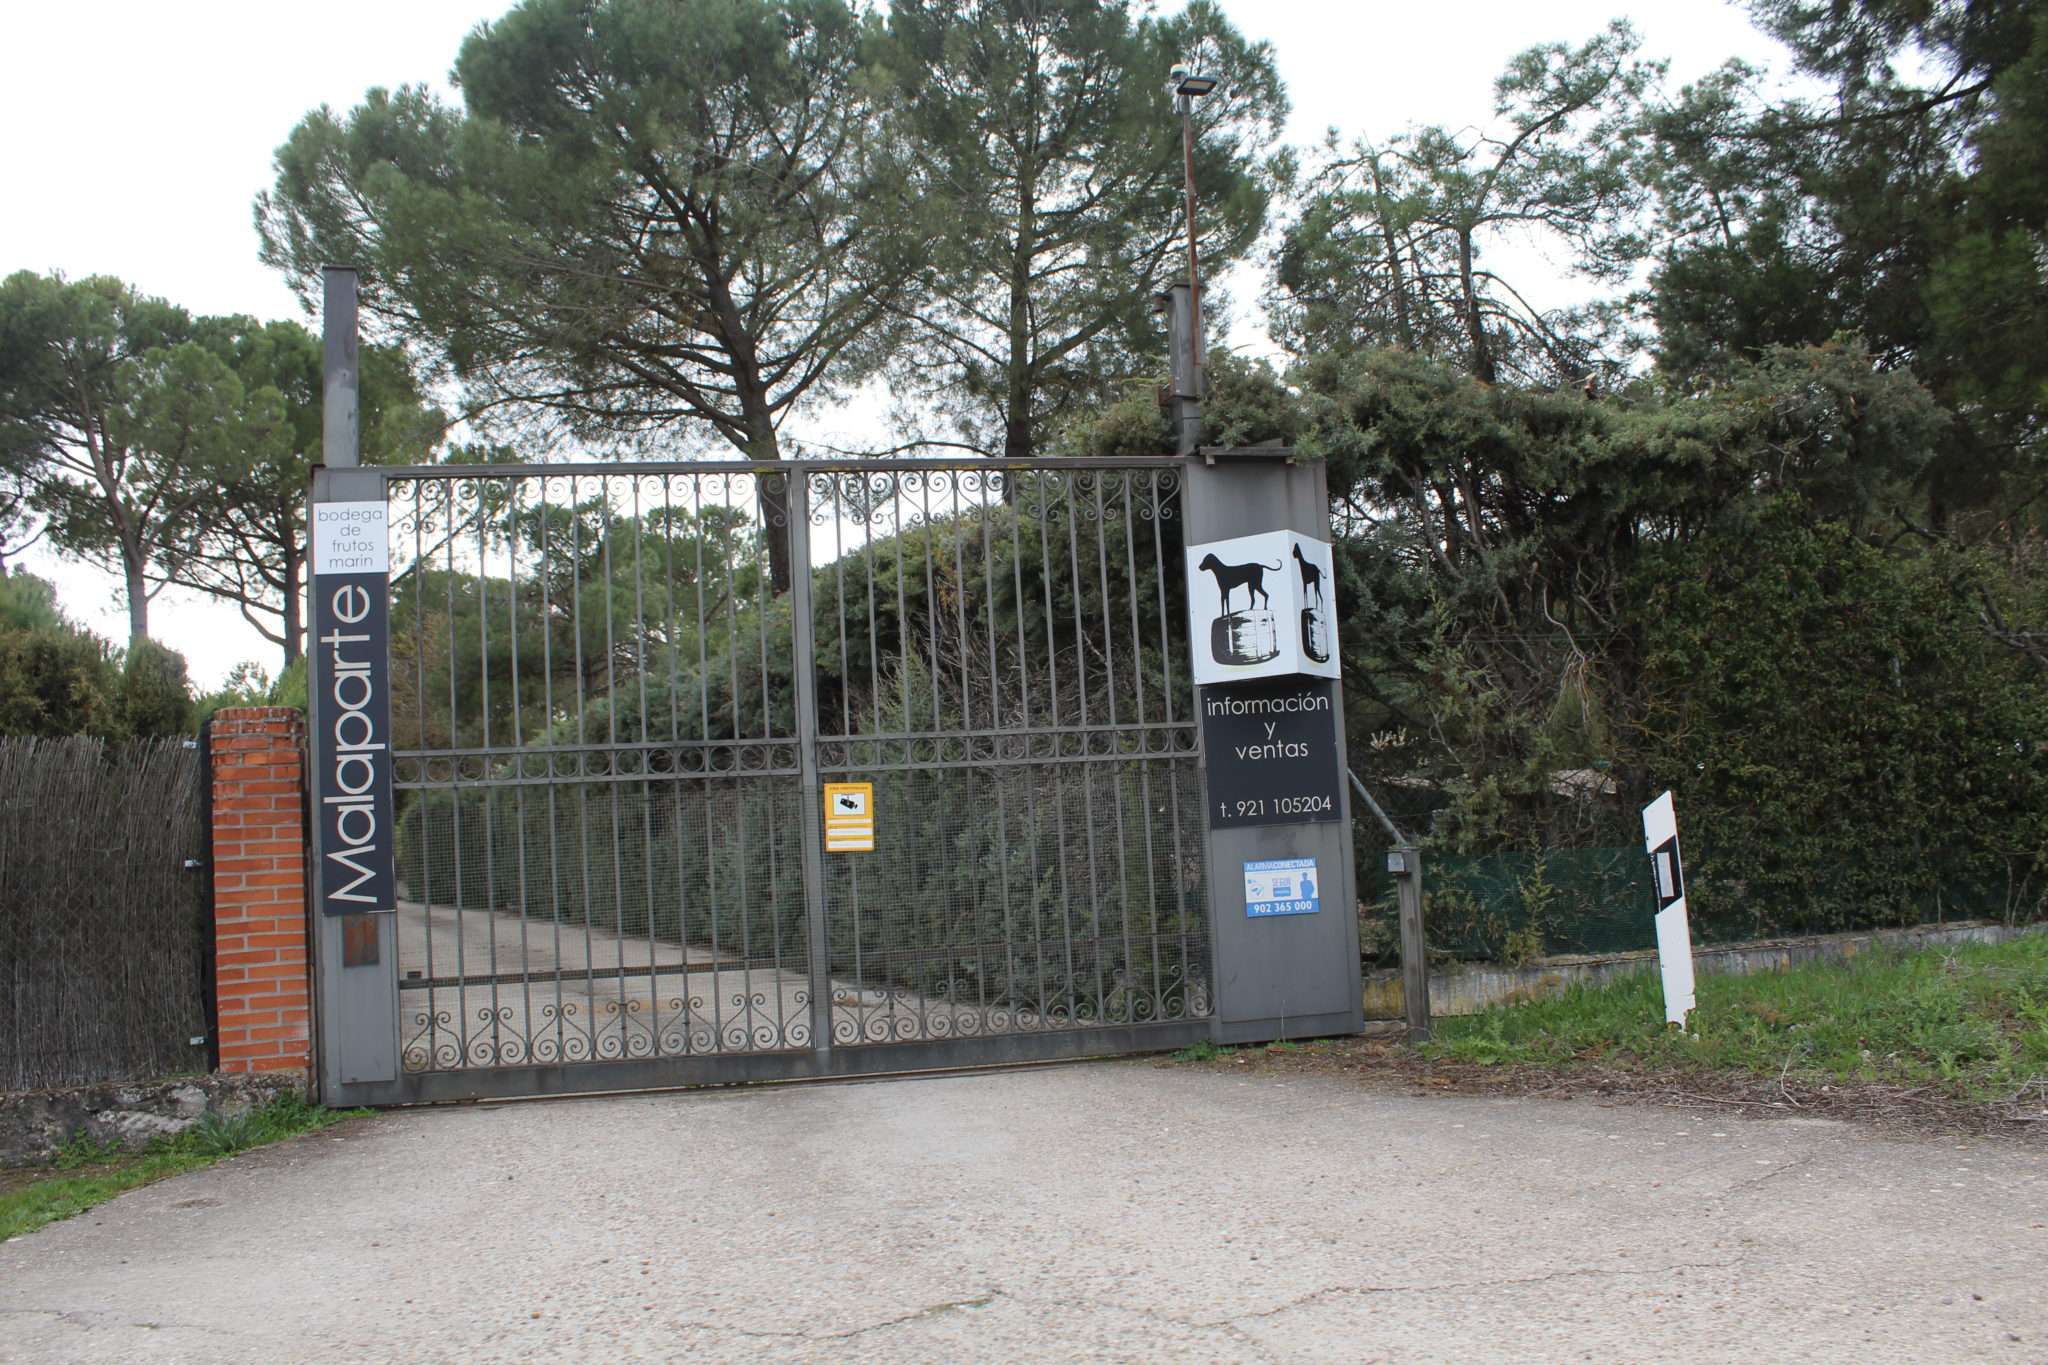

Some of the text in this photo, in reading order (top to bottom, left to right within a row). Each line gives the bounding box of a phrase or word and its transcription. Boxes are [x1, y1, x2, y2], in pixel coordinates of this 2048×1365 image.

[318, 507, 383, 524] bodega
[340, 523, 361, 537] de
[332, 539, 375, 553] frutos
[1207, 691, 1329, 716] información
[1263, 721, 1276, 741] y
[320, 584, 386, 904] Malaparte
[1235, 740, 1309, 760] ventas
[1219, 795, 1332, 818] t. 921 105204
[1254, 900, 1313, 914] 902 365 000
